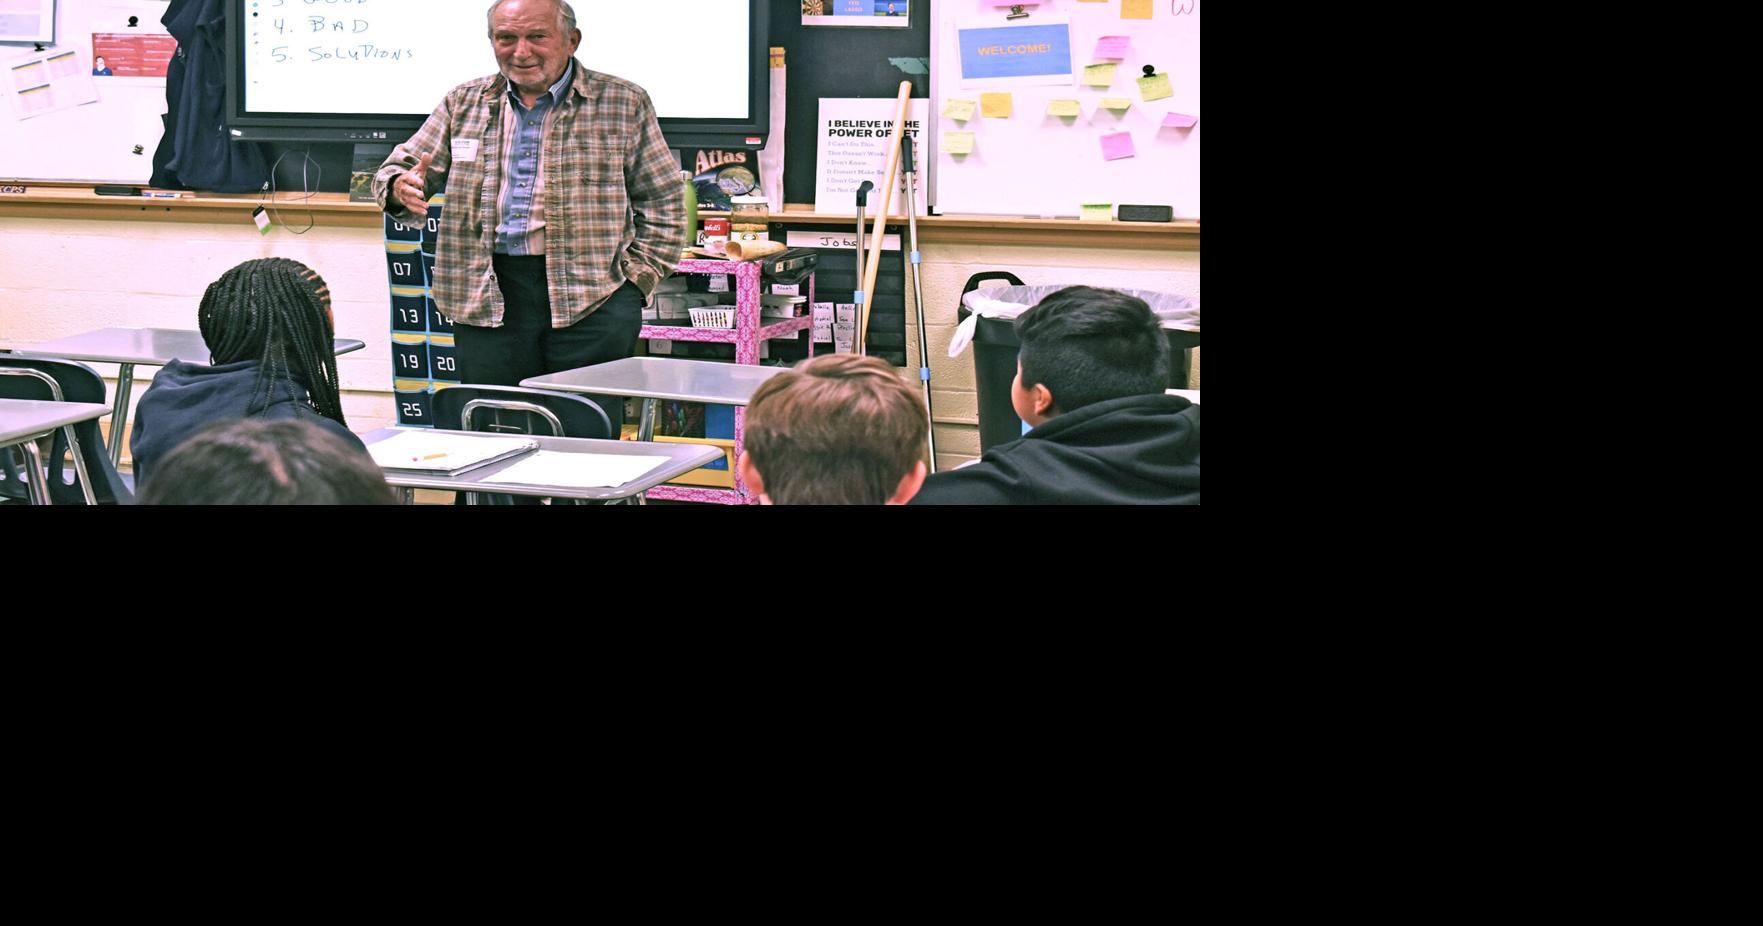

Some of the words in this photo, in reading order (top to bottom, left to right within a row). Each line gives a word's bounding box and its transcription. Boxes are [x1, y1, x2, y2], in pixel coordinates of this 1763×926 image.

[273, 18, 293, 35] 4.
[307, 16, 369, 33] BAD
[271, 46, 293, 62] 5.
[834, 120, 881, 128] BELIEVE
[883, 120, 893, 128] IN
[904, 120, 920, 128] HE
[828, 129, 873, 137] POWER
[875, 129, 892, 138] OF
[903, 129, 920, 138] ET
[695, 150, 747, 176] Atlas
[393, 262, 411, 276] 07
[399, 308, 419, 323] 13
[435, 311, 454, 326] 14
[401, 353, 419, 369] 19
[437, 356, 456, 372] 20
[401, 403, 422, 417] 25
